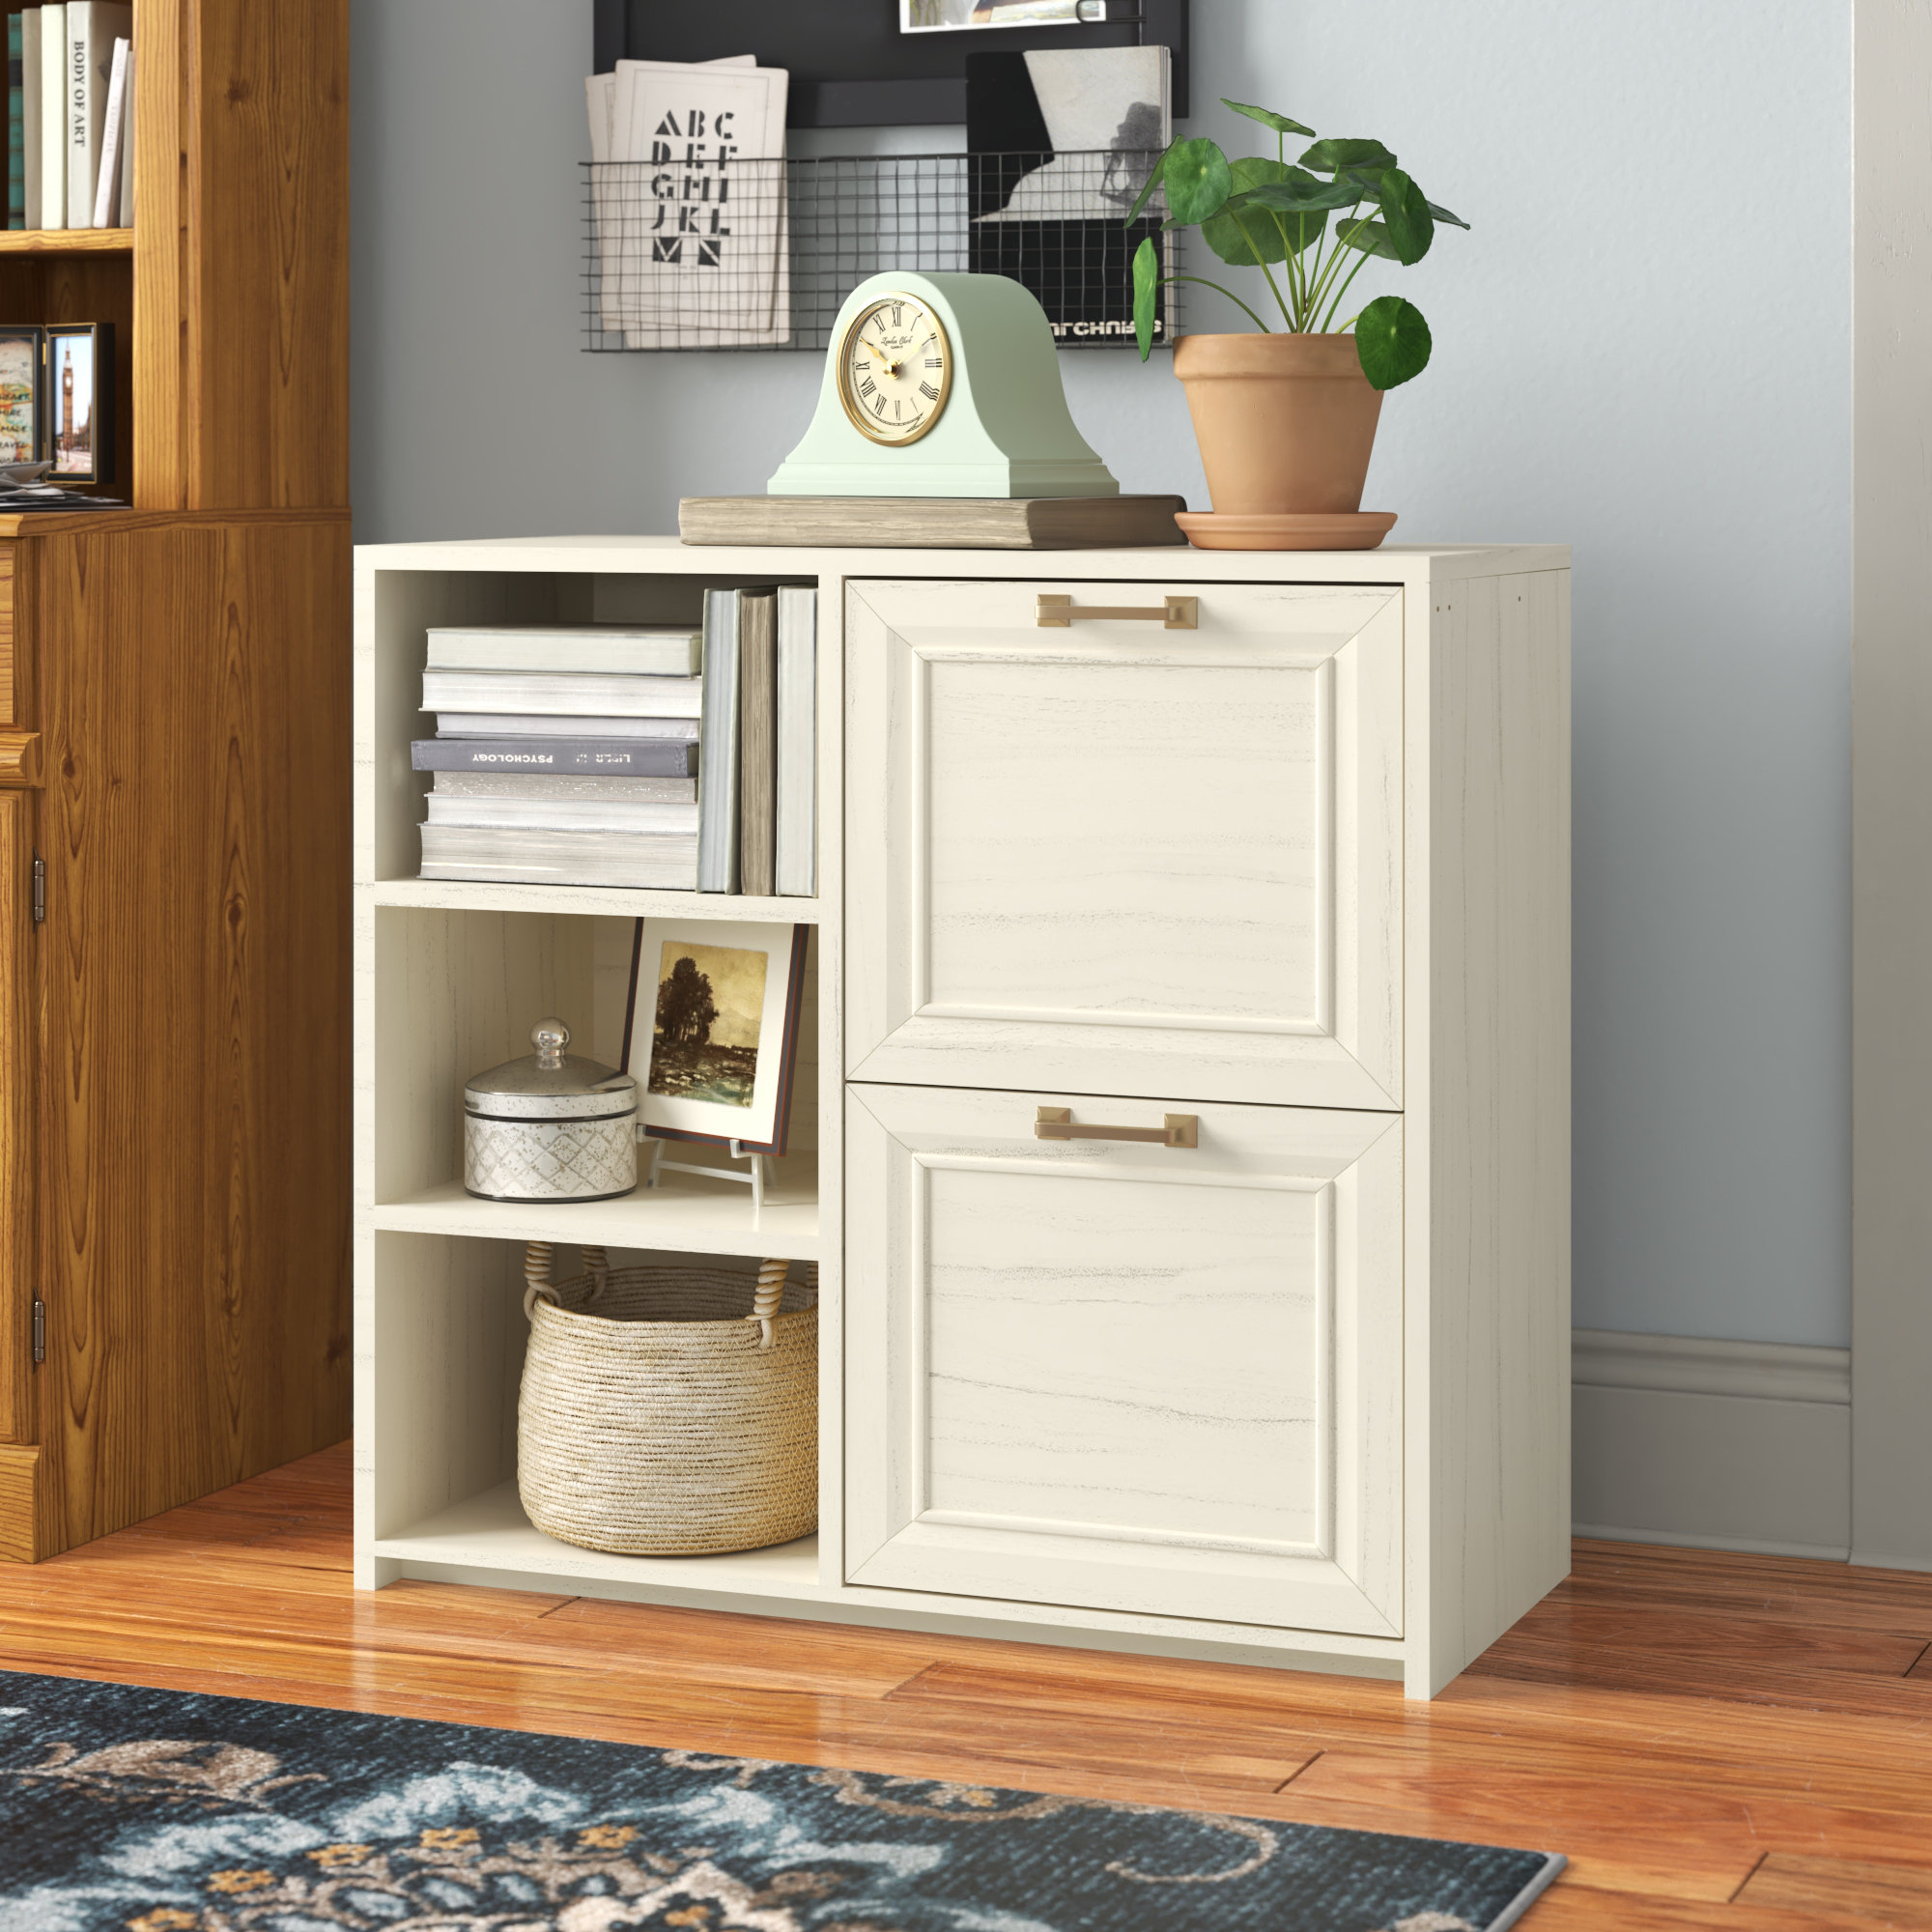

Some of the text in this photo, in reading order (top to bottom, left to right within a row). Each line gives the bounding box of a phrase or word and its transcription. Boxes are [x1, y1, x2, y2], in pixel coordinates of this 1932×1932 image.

[73, 41, 85, 147] BODY OF ART
[472, 753, 554, 763] PSYCHOLOGY
